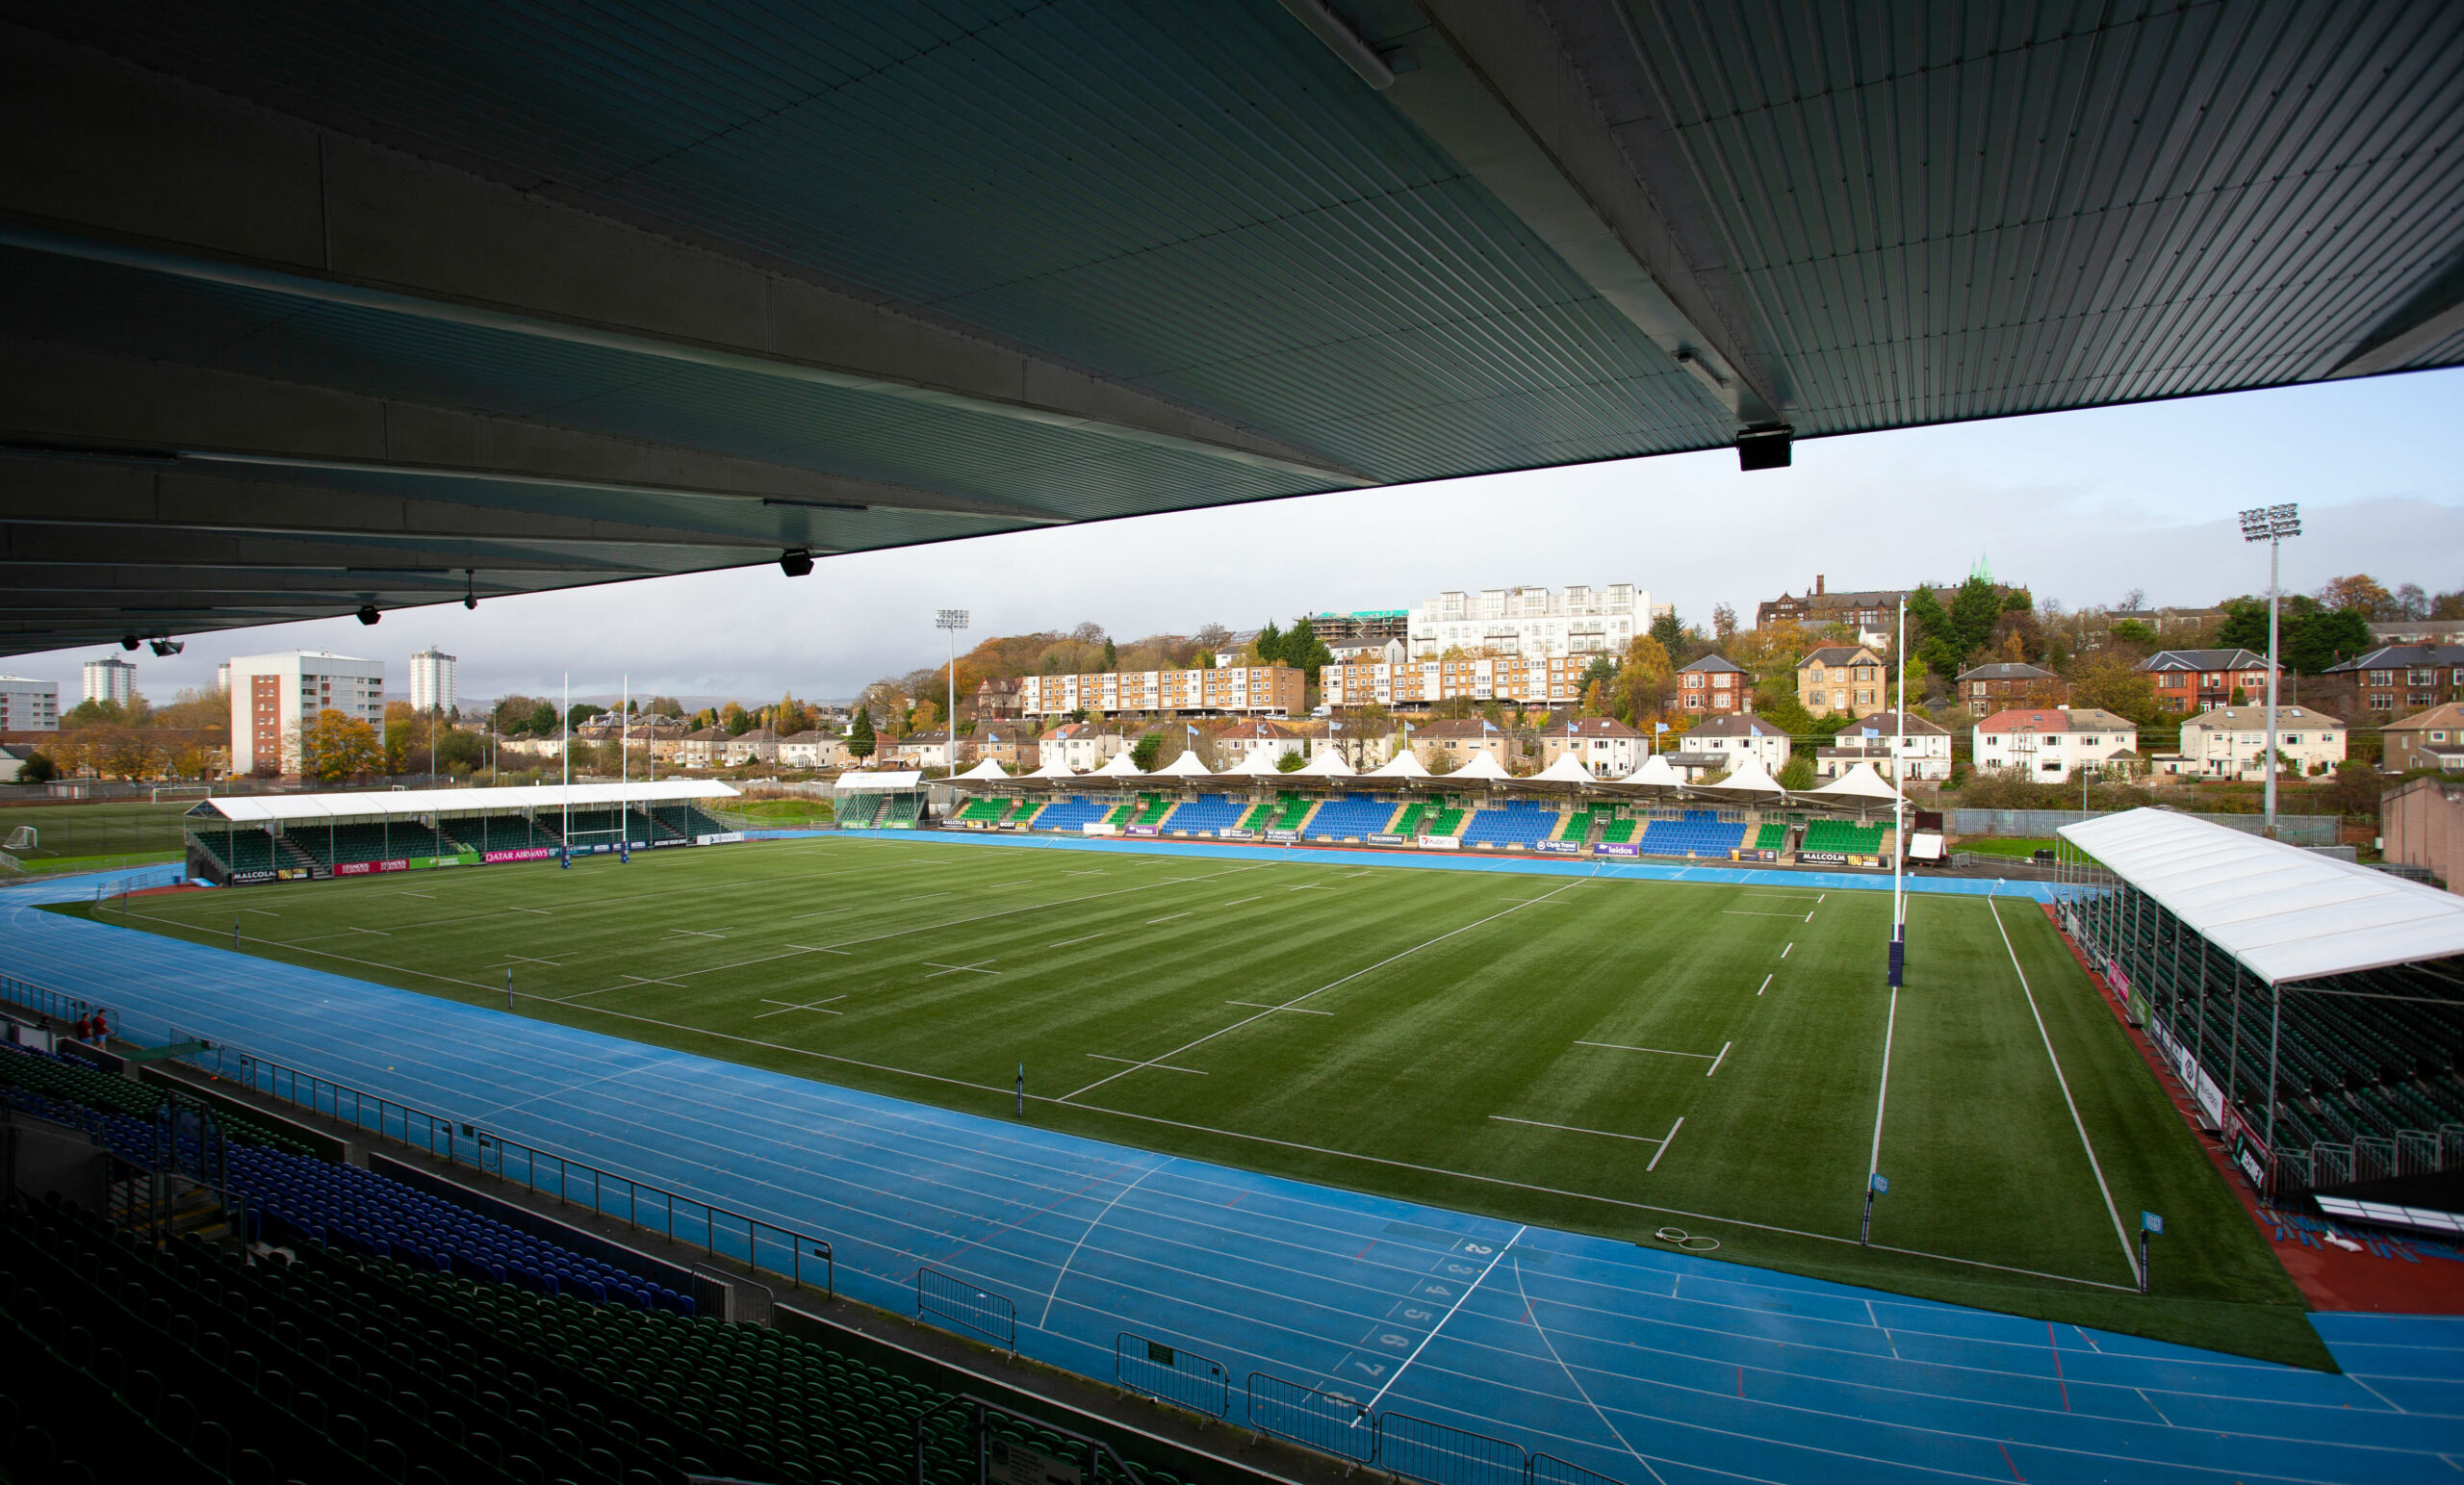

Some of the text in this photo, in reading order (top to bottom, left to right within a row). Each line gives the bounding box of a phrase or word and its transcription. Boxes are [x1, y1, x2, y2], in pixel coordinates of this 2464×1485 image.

[486, 851, 514, 862] QATAR
[515, 848, 549, 859] AIRWAYS
[1803, 853, 1846, 861] MALCOLM
[1847, 855, 1863, 866] 100
[233, 870, 277, 880] MALCOLM
[276, 869, 293, 880] 100
[1465, 1242, 1493, 1255] 2
[1447, 1263, 1475, 1275] 3
[1424, 1285, 1452, 1297] 4
[1403, 1308, 1433, 1322] 5
[1378, 1333, 1410, 1347] 6
[1354, 1361, 1387, 1377] 7
